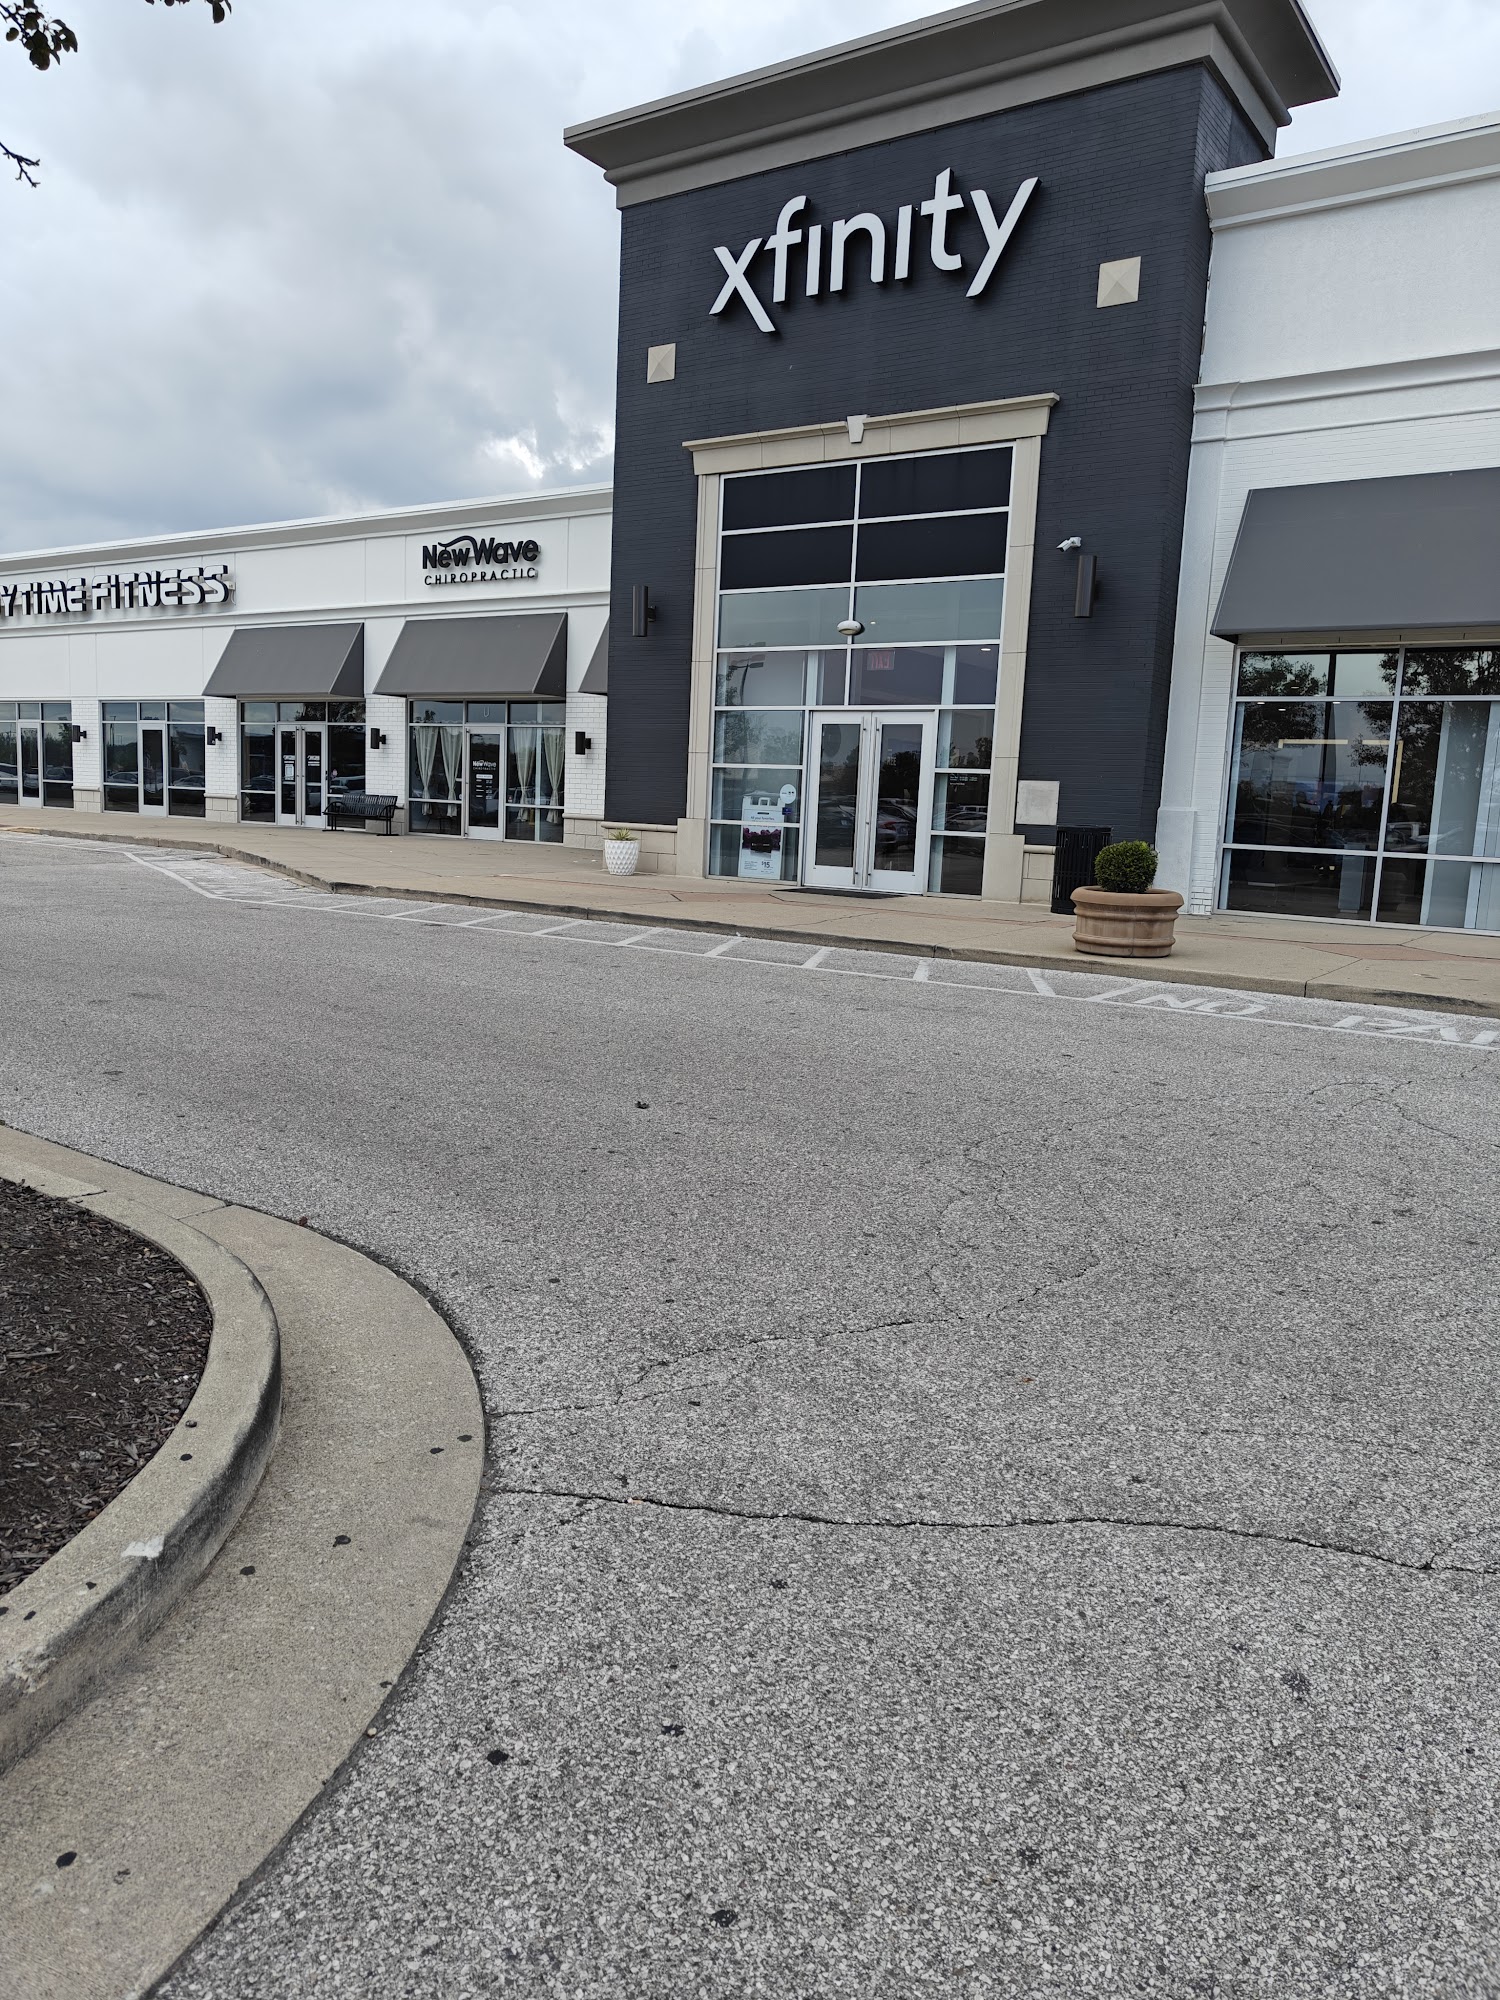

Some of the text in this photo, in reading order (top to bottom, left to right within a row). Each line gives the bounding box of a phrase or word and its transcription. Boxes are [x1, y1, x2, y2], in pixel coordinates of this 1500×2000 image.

[708, 167, 1041, 333] xfinity
[422, 535, 540, 569] New Wave
[92, 564, 228, 610] FITNESS
[424, 567, 538, 585] CHIROPRACTIC
[1133, 994, 1267, 1017] NO
